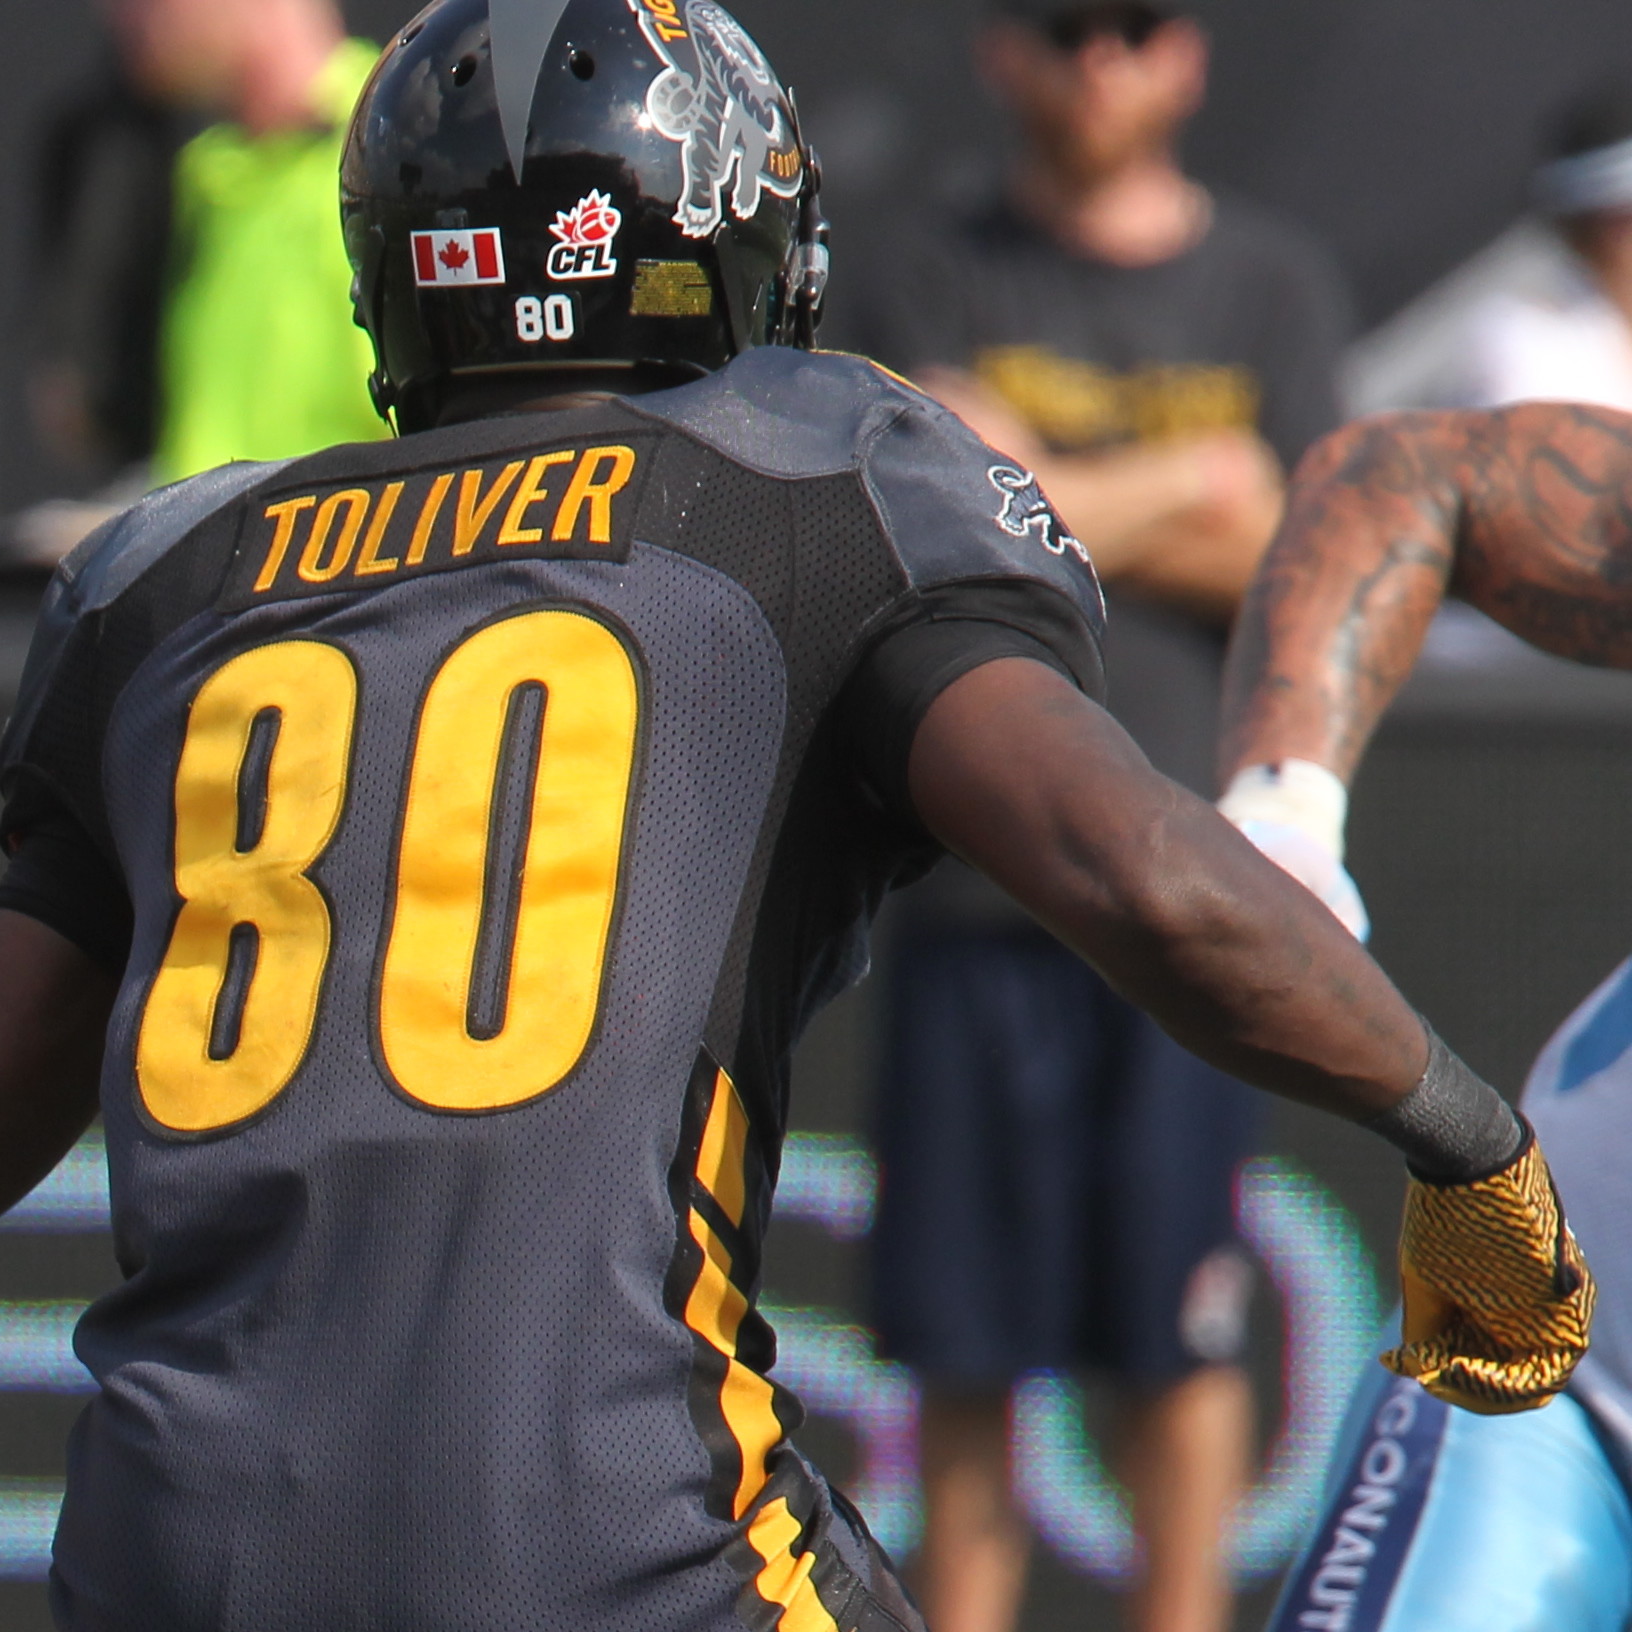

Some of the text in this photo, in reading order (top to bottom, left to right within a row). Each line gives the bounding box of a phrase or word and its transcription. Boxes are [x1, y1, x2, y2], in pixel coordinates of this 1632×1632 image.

[550, 243, 610, 274] CFL
[515, 294, 574, 341] 80
[253, 444, 636, 593] TOLIVER
[134, 608, 640, 1134] 80
